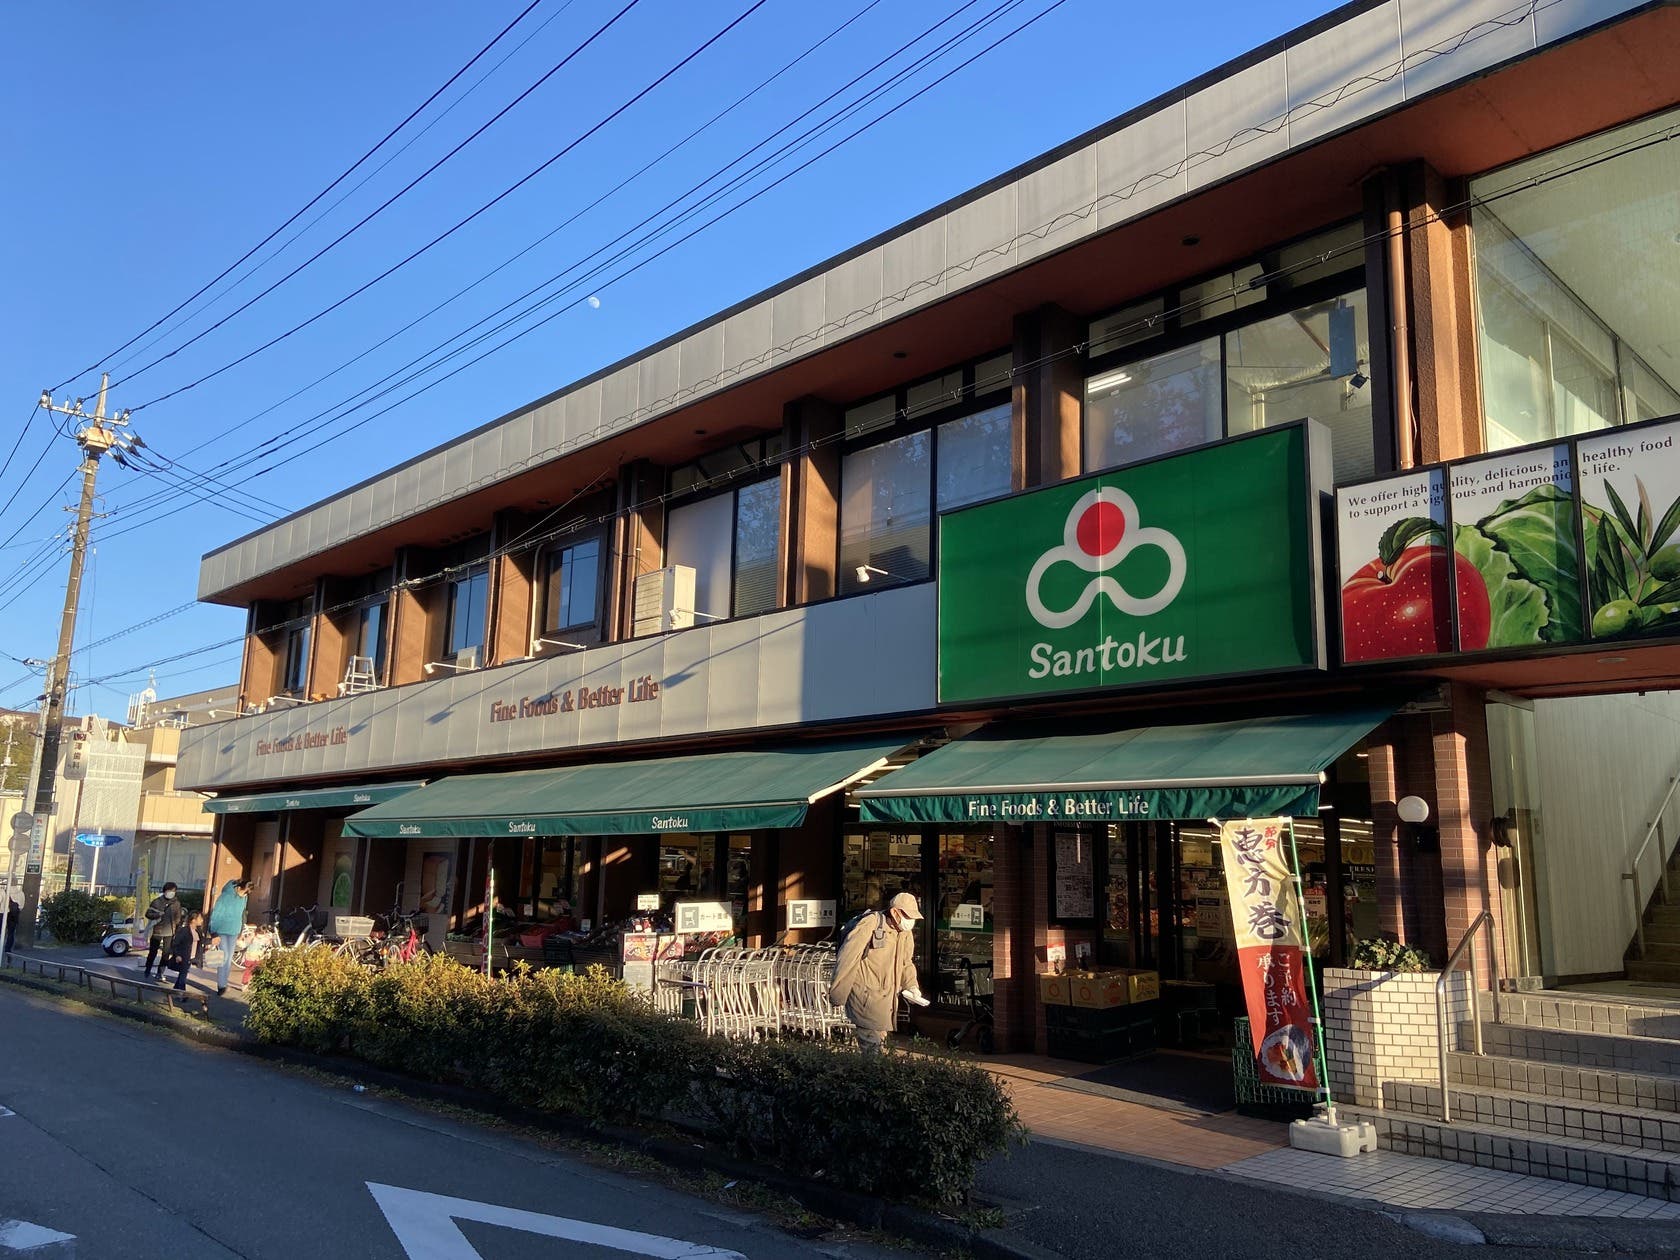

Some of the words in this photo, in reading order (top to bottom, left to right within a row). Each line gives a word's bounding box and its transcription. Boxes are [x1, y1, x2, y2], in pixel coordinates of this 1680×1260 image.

[1348, 497, 1367, 507] We
[1370, 490, 1398, 503] offer
[1402, 483, 1428, 498] high
[1485, 463, 1548, 481] delicious,
[1553, 459, 1569, 469] an
[1583, 446, 1634, 463] healthy
[1640, 436, 1673, 452] food
[1349, 510, 1360, 519] to
[1364, 501, 1408, 516] support
[1412, 500, 1419, 508] a
[1481, 482, 1504, 496] and
[1593, 462, 1621, 475] life.
[1028, 631, 1188, 679] Santoku
[490, 700, 517, 723] Fine
[519, 696, 559, 719] Foods
[560, 690, 574, 713] &
[578, 685, 625, 710] Better
[628, 675, 659, 703] Life
[256, 739, 271, 756] Fine
[272, 737, 294, 754] Foods
[295, 734, 303, 750] &
[304, 732, 329, 749] Better
[330, 726, 347, 745] Life
[400, 824, 421, 834] Santoku
[508, 821, 536, 834] Santoku
[651, 816, 688, 831] Santoku
[968, 800, 997, 816] Fine
[1001, 798, 1043, 816] Foods
[1047, 799, 1059, 815] &
[1065, 798, 1112, 815] Better
[1118, 794, 1149, 815] Life
[1264, 826, 1277, 850] 節分
[1232, 826, 1292, 940] 恵方巻
[1256, 953, 1283, 1025] 承ります
[1278, 953, 1297, 1006] ご予約
